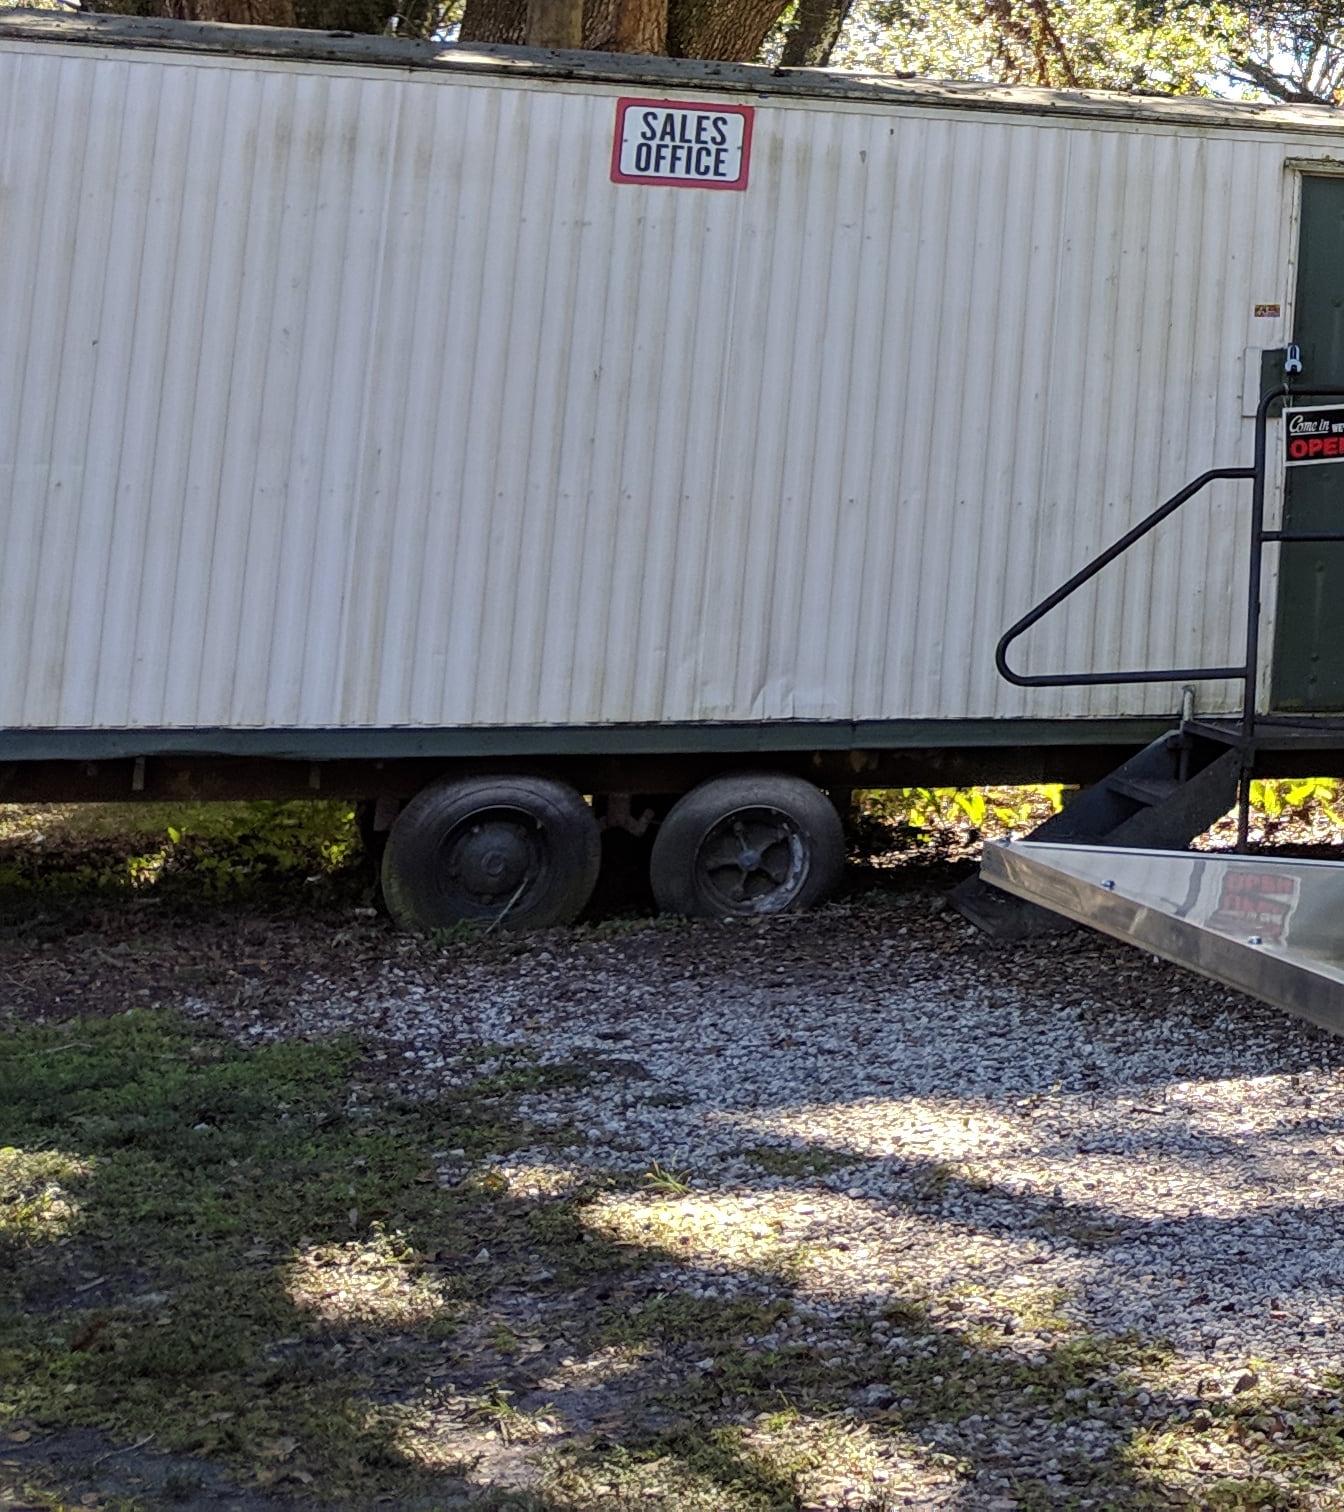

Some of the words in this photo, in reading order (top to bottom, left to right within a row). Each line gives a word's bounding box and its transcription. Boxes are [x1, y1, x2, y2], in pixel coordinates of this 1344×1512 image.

[640, 111, 728, 146] SALES
[635, 142, 729, 177] OFFICE
[1289, 414, 1318, 433] Come
[1319, 418, 1330, 431] in
